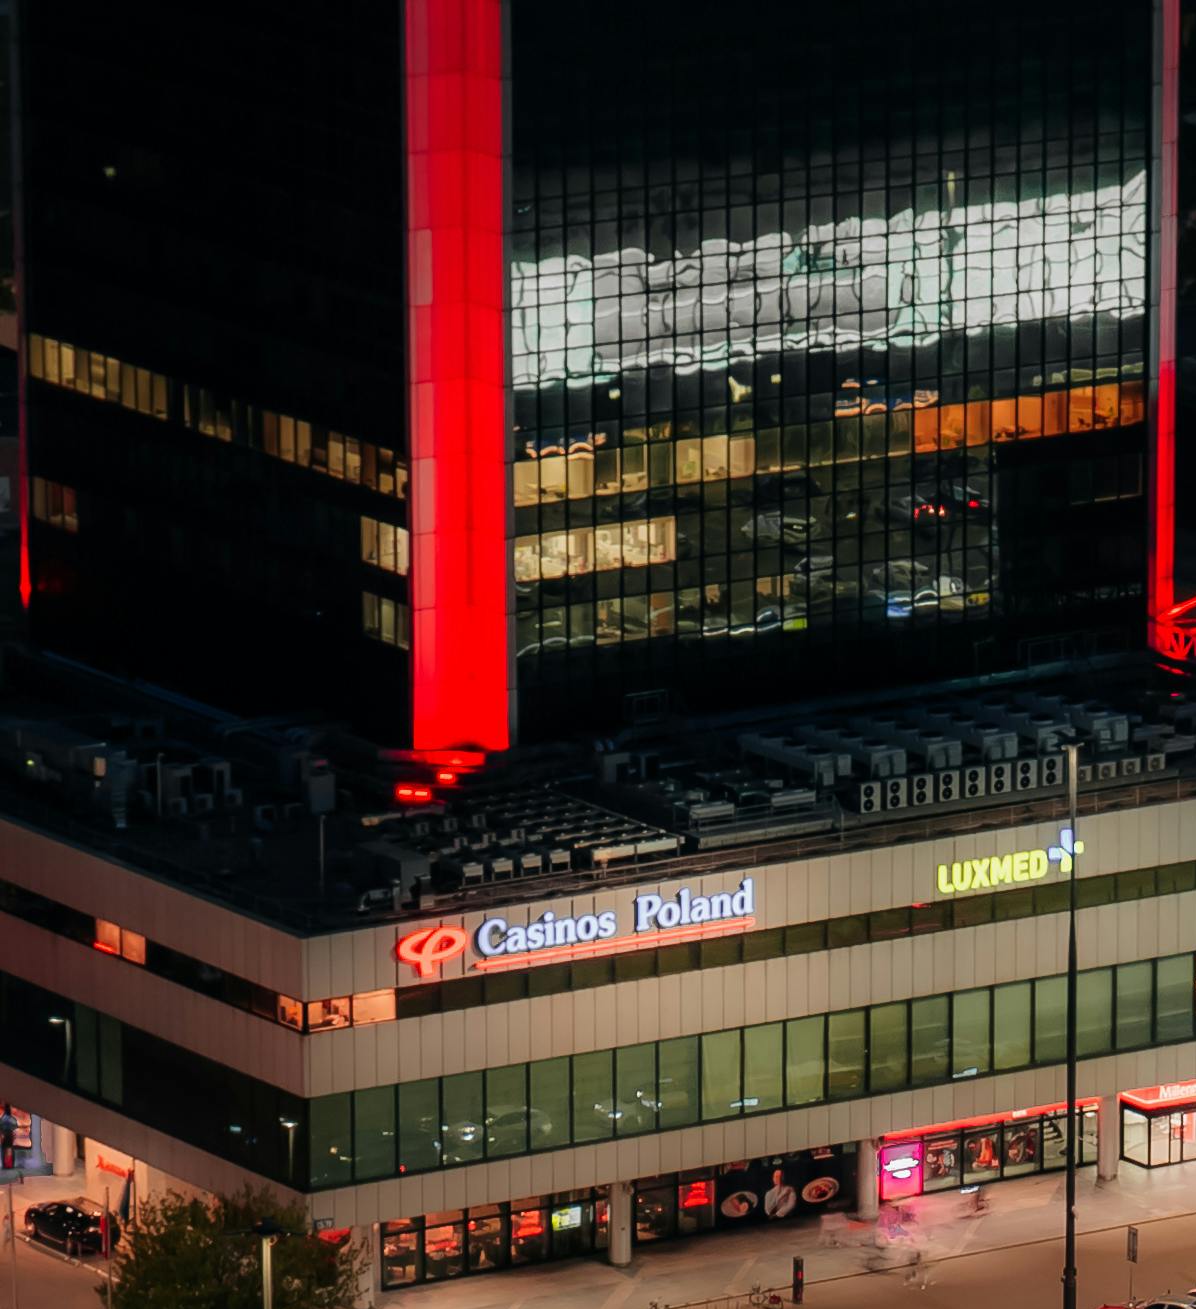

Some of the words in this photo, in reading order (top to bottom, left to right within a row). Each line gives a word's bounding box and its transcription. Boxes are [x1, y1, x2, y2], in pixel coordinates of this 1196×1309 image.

[937, 849, 1049, 894] LUXMED
[475, 910, 616, 957] Casinos
[634, 877, 754, 932] Poland
